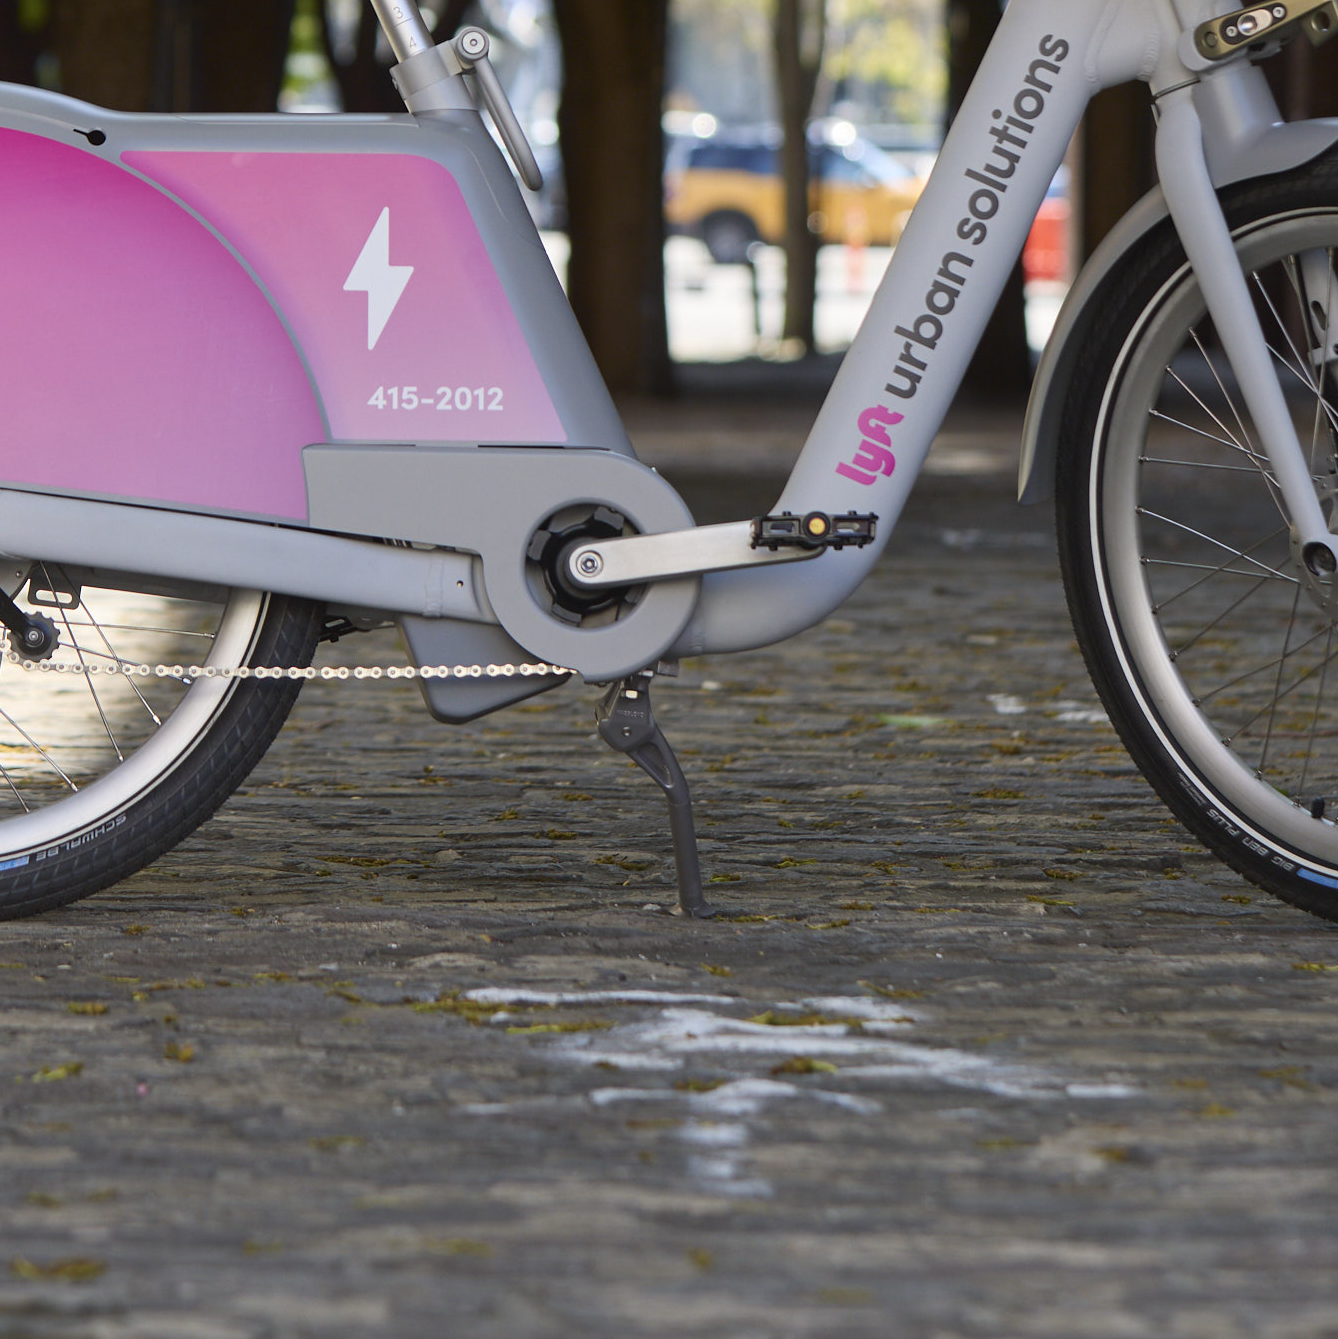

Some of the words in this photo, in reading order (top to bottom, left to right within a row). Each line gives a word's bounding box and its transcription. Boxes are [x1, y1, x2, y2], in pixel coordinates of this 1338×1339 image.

[393, 6, 403, 20] 3
[409, 36, 417, 49] 4
[836, 404, 905, 486] lyft
[885, 251, 975, 400] urban
[957, 34, 1070, 246] solutions
[367, 386, 504, 411] 415-2012
[1206, 808, 1240, 839] PLUS
[36, 813, 127, 862] SCHWALBE
[1271, 855, 1296, 872] BIG
